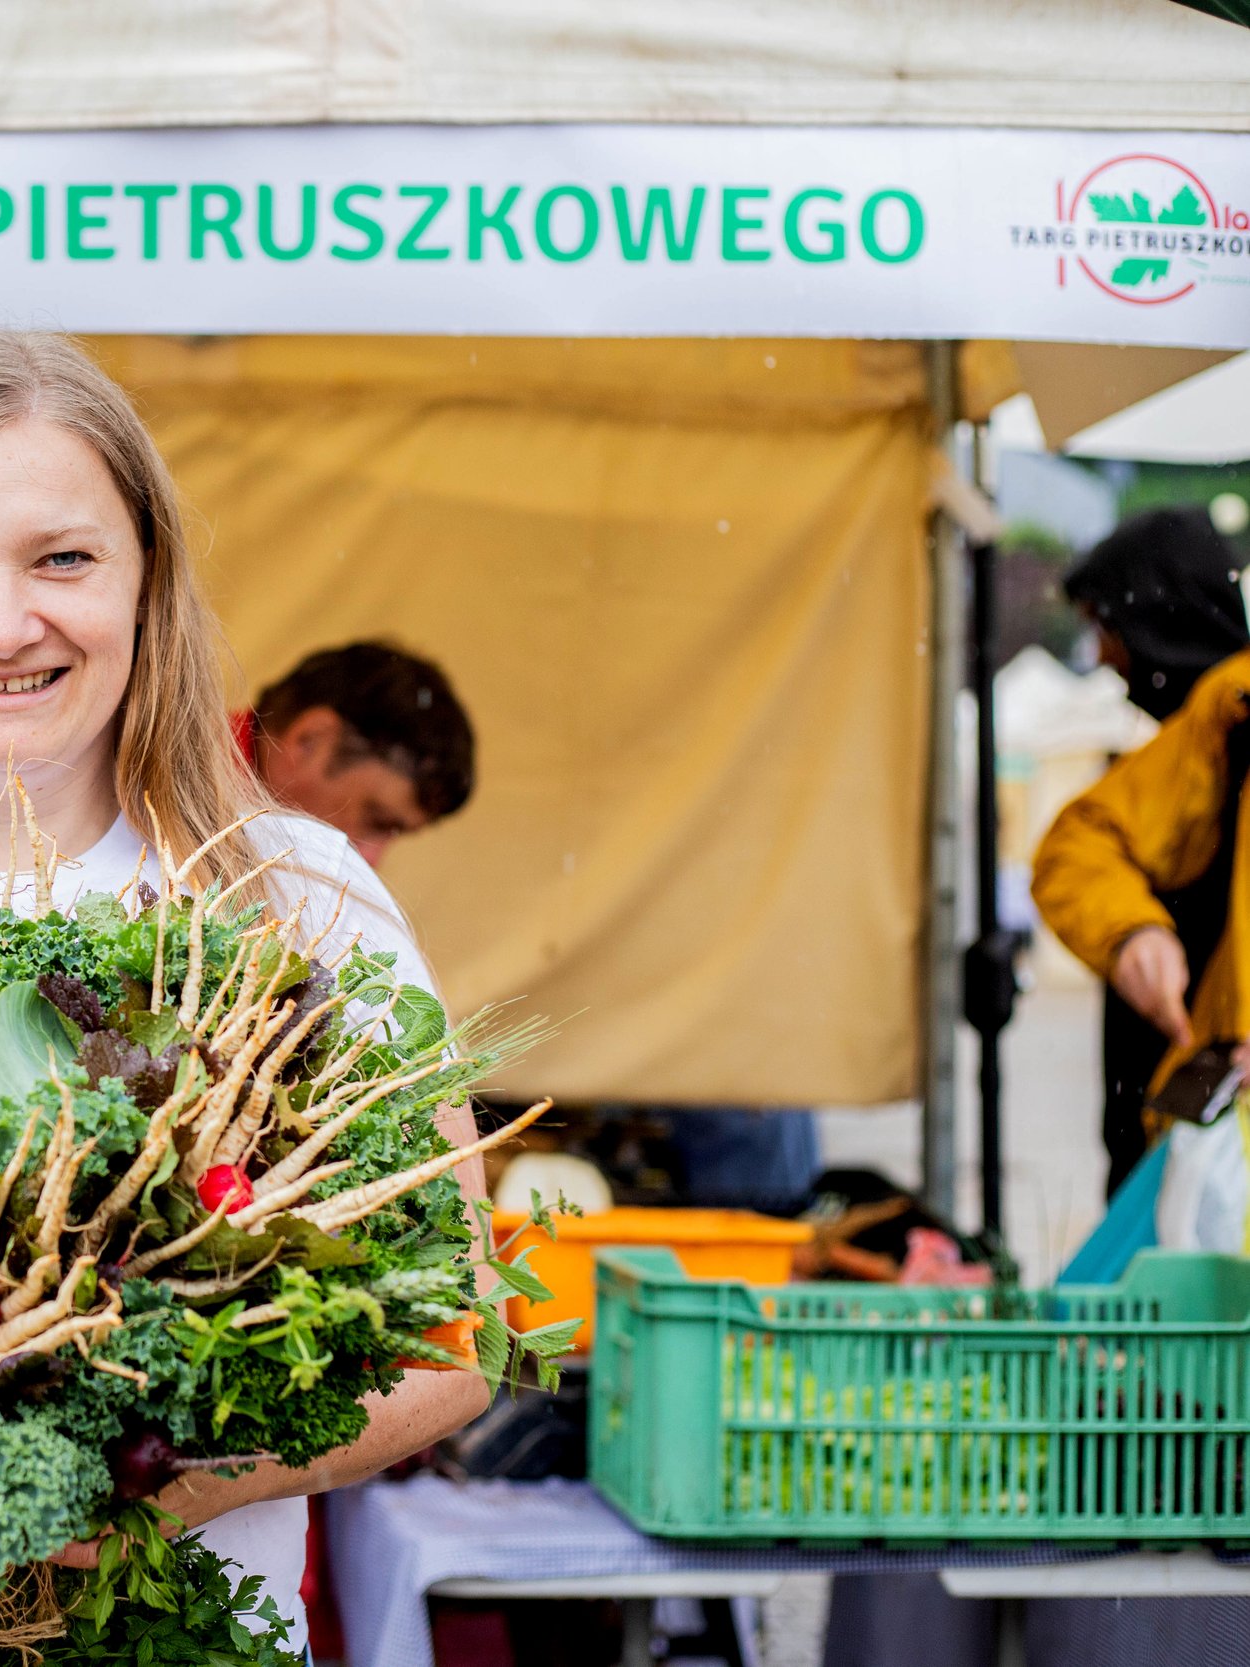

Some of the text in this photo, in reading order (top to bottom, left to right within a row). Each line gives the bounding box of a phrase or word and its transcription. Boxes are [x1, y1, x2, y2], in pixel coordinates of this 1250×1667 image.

[1224, 203, 1250, 230] la
[1010, 225, 1250, 256] TARG PIETRUSZKO
